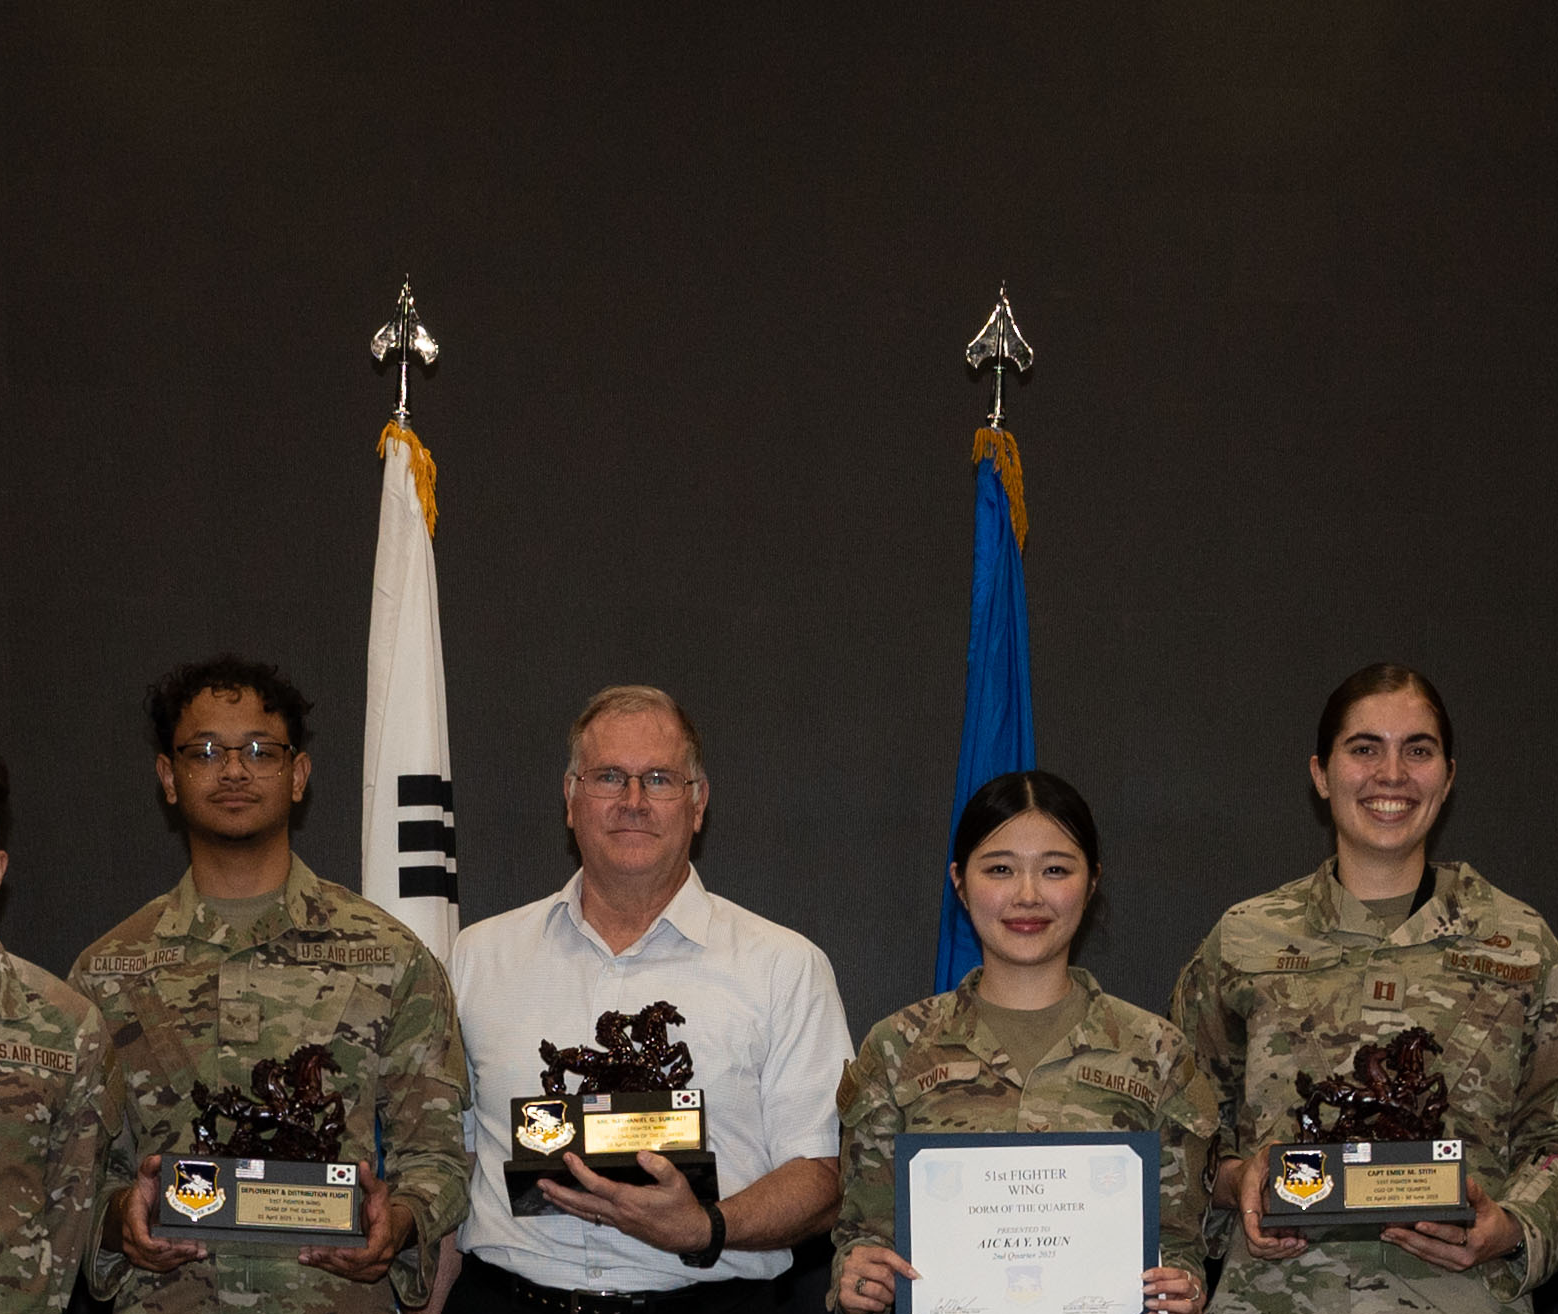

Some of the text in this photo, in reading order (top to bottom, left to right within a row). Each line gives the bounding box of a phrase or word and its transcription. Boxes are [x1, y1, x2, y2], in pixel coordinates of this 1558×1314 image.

[94, 947, 180, 973] CALDERON-ARCE
[301, 943, 392, 965] U.S. AIR FORCE
[1276, 956, 1310, 969] STITH
[1473, 957, 1492, 974] AIR
[1494, 962, 1531, 981] FORCE
[12, 1044, 33, 1065] AIR
[35, 1048, 74, 1073] FORCE
[1105, 1074, 1125, 1092] AIR
[985, 1168, 1067, 1182] 51st FIGHTER
[329, 1191, 349, 1199] FLIGHT
[1008, 1184, 1044, 1195] WING
[968, 1202, 1085, 1215] DORM OF THE QUARTER
[1036, 1236, 1071, 1247] YOUN
